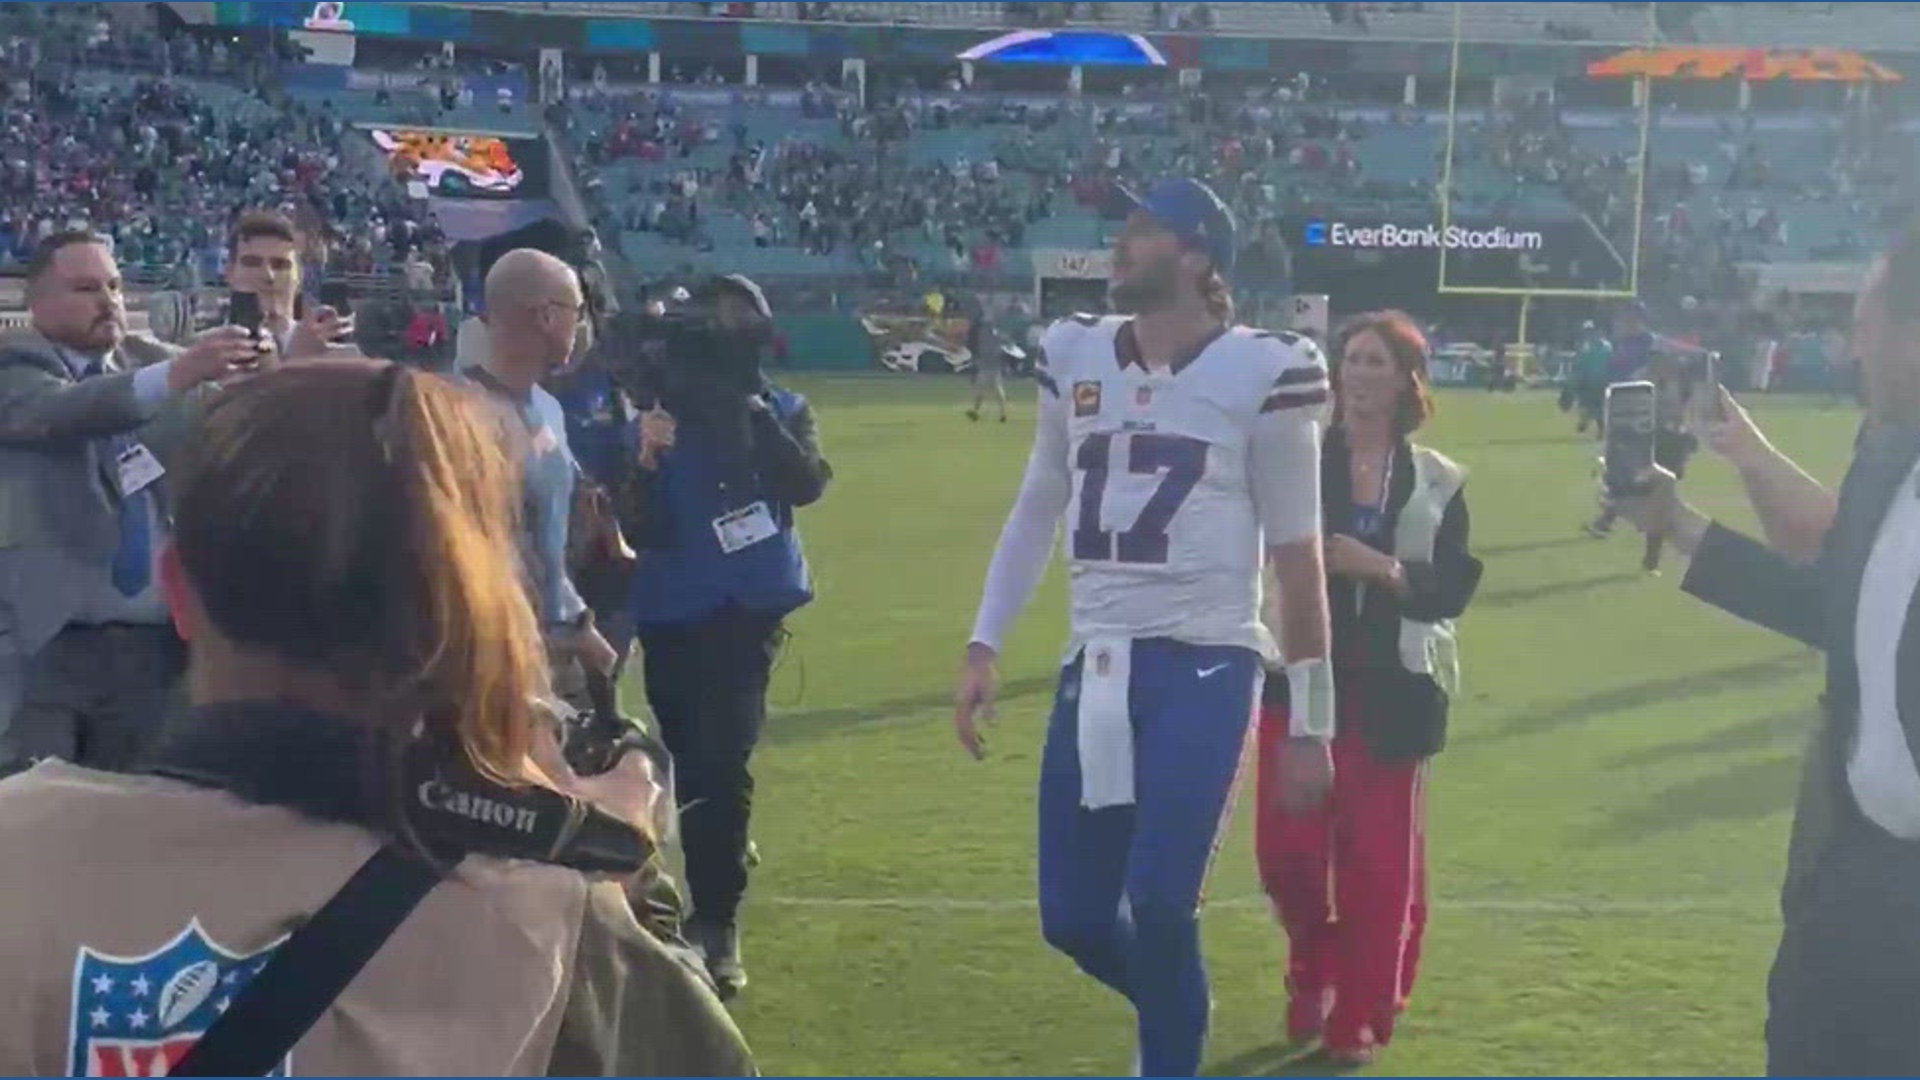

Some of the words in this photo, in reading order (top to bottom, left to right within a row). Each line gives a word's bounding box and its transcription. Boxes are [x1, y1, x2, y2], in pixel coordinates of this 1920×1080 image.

[1330, 222, 1441, 247] EverBank
[1443, 225, 1542, 249] Stadium
[1073, 432, 1213, 564] 17
[418, 780, 537, 833] Canon
